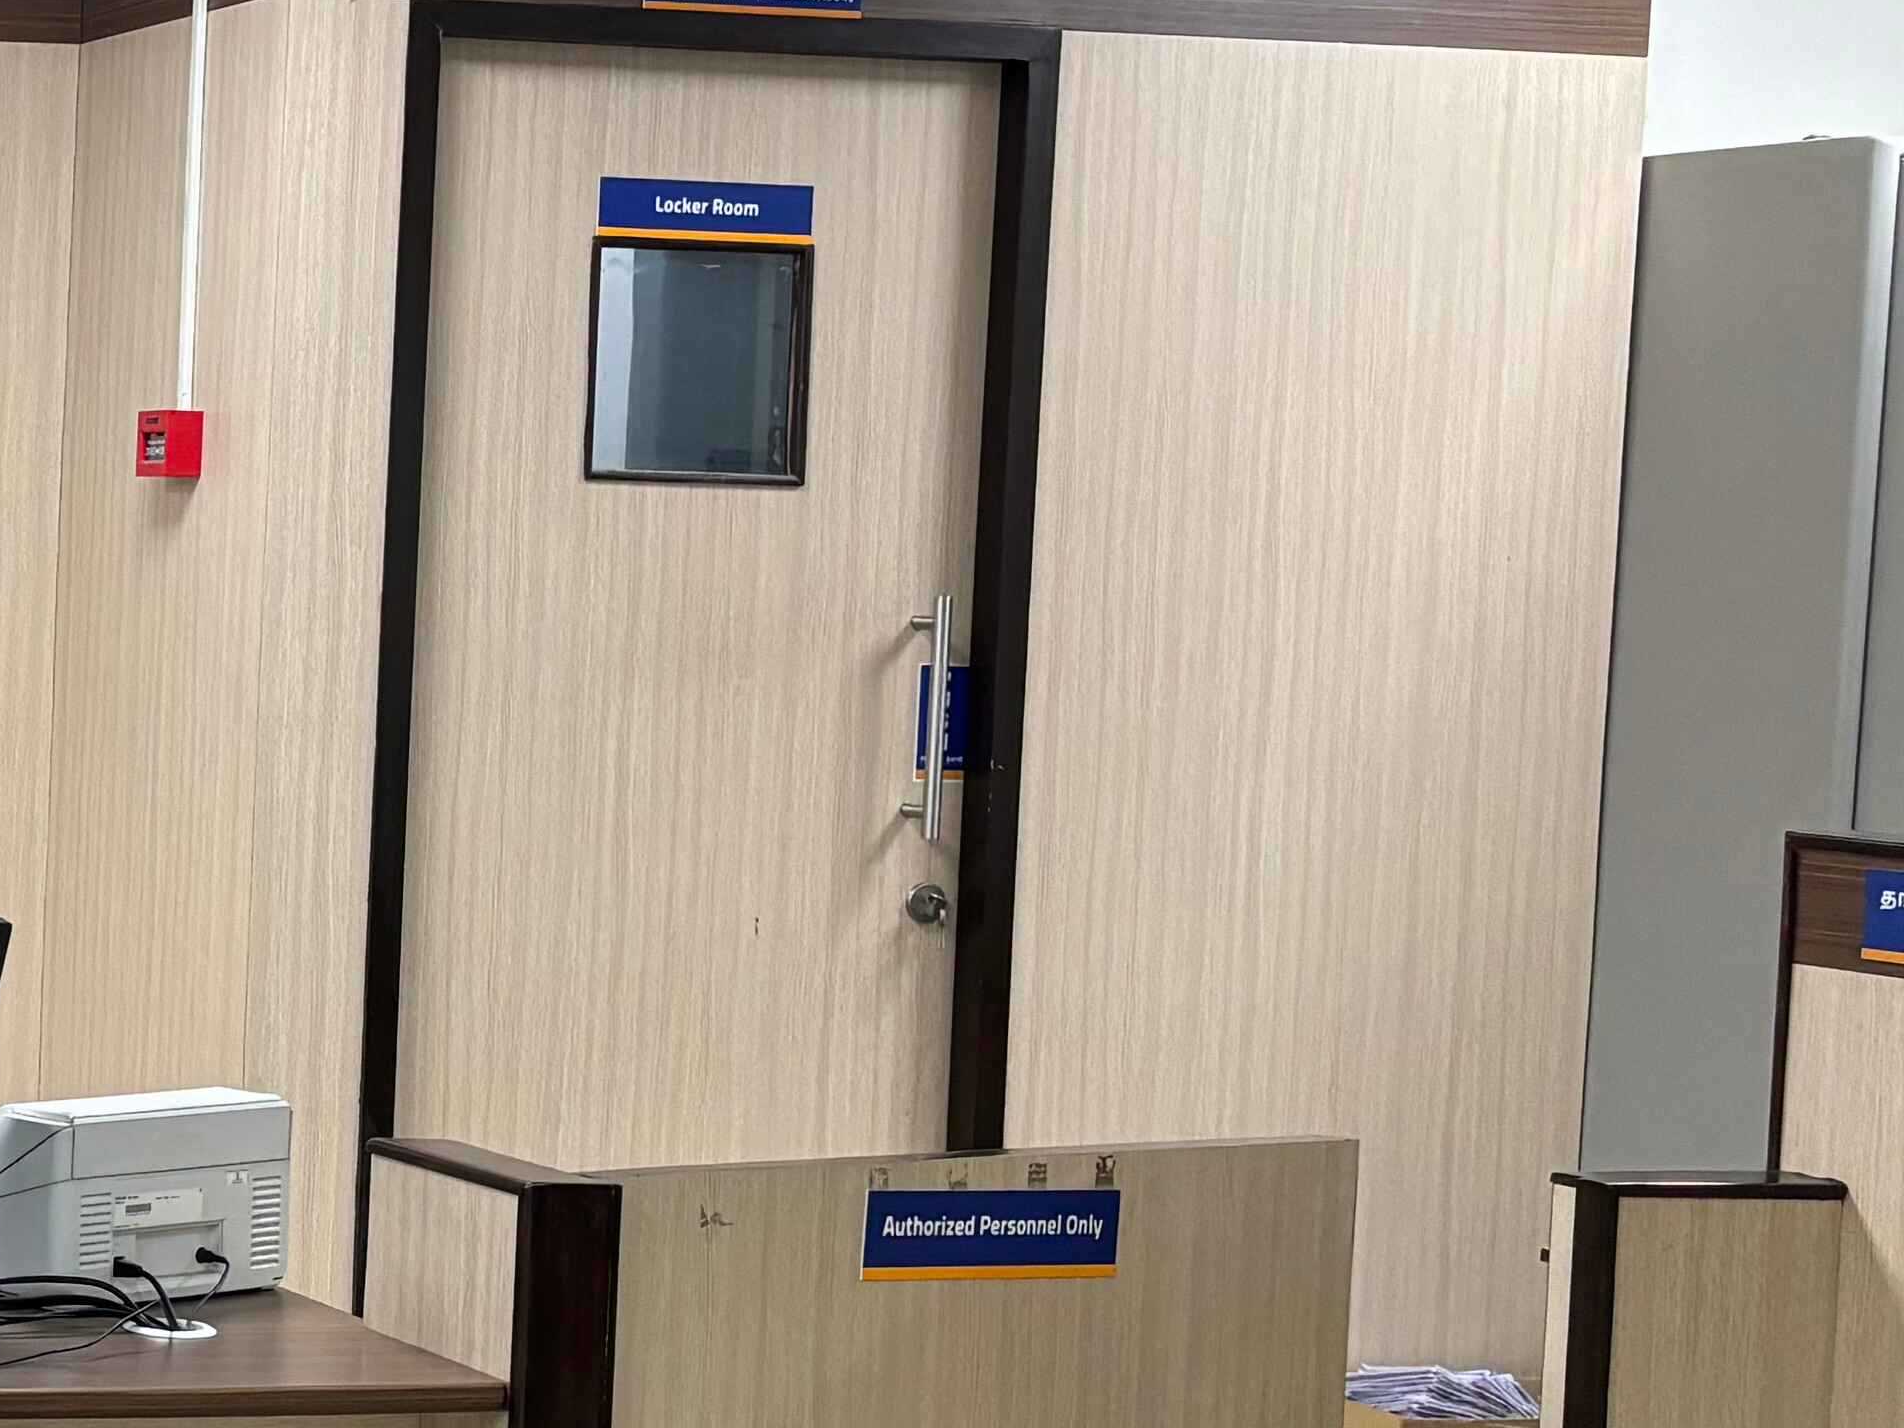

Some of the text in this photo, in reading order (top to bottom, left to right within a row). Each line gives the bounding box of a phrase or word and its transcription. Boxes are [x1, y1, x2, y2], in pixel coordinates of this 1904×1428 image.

[655, 195, 759, 217] Locker Room
[883, 1214, 1104, 1240] Authorized Personnel Only
